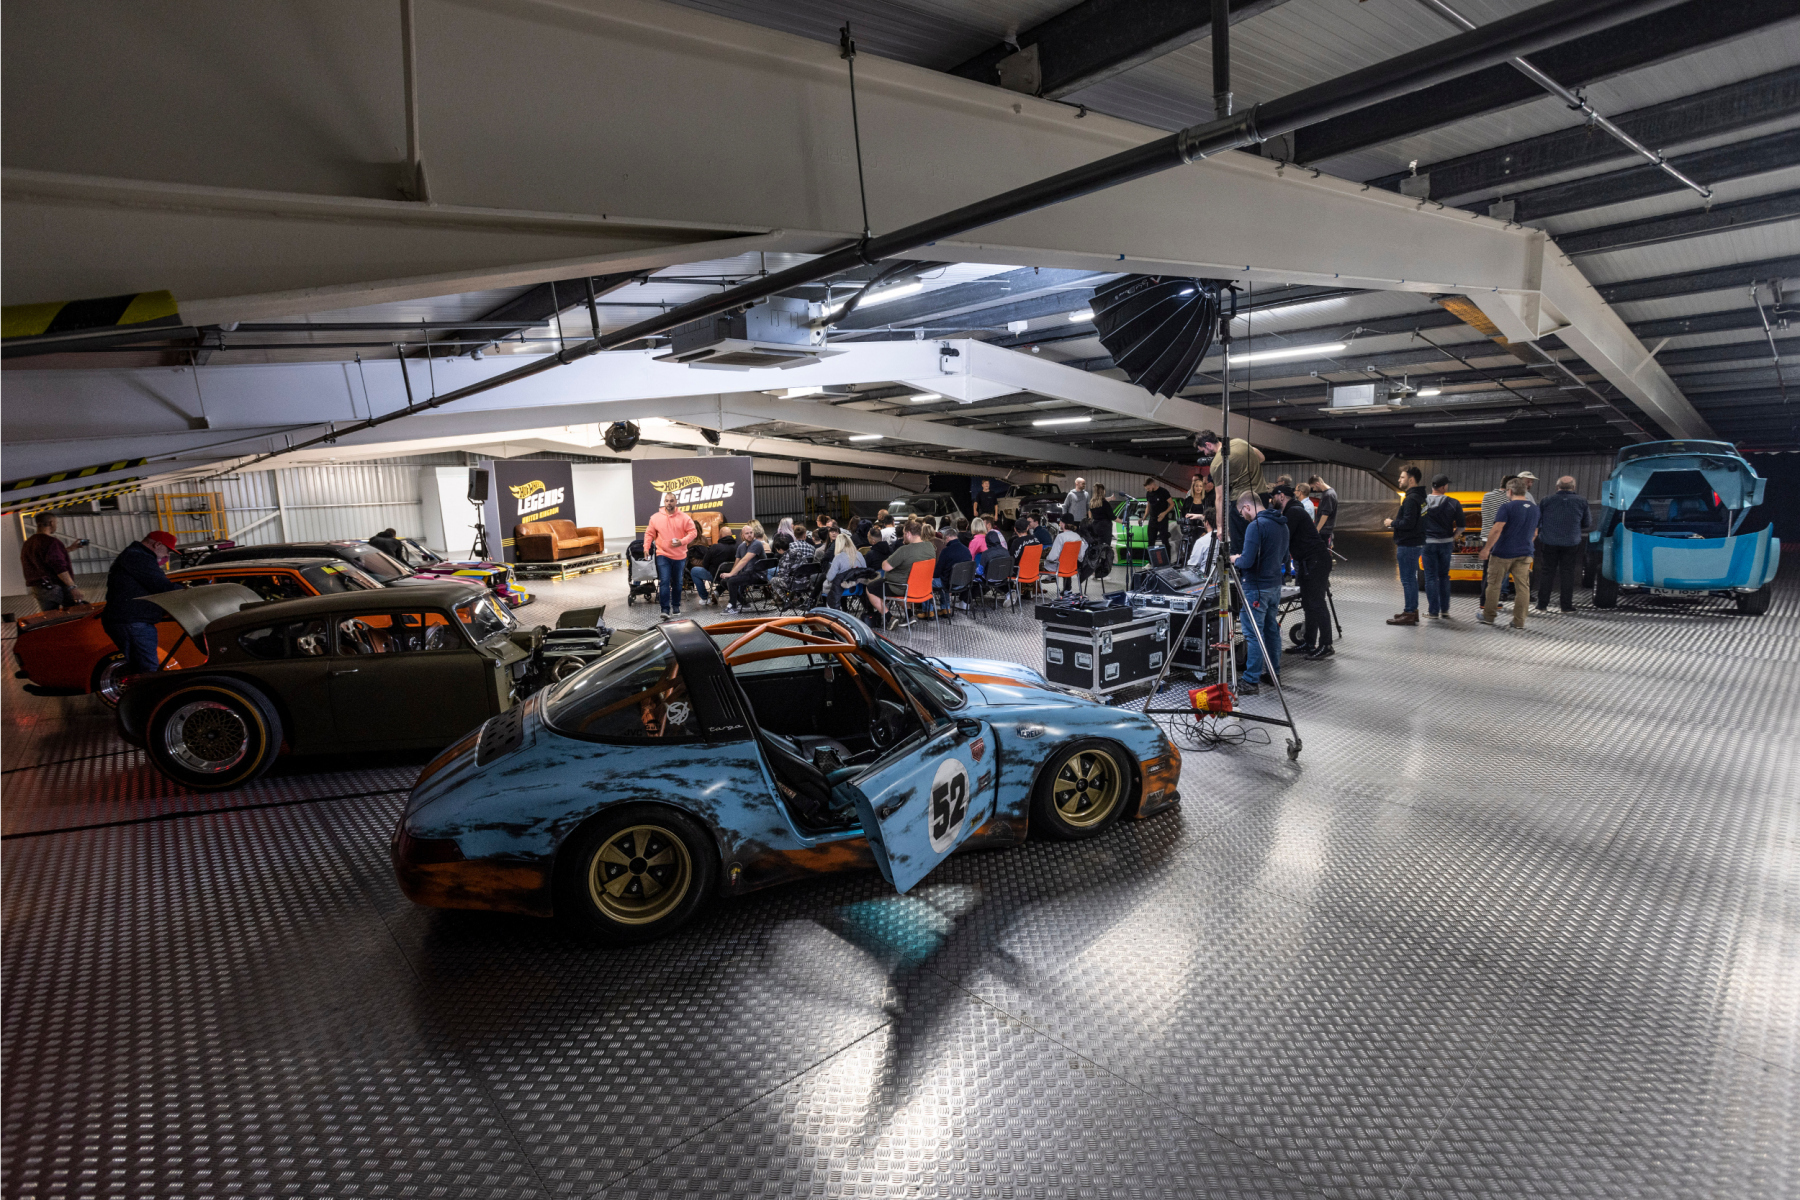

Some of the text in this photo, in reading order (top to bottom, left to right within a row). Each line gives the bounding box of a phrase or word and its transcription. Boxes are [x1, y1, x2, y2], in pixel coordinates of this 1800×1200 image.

[665, 476, 701, 492] HOT WHEELS
[517, 486, 565, 516] LEGENDS
[691, 500, 724, 511] KINGDOM
[932, 772, 966, 841] 52
